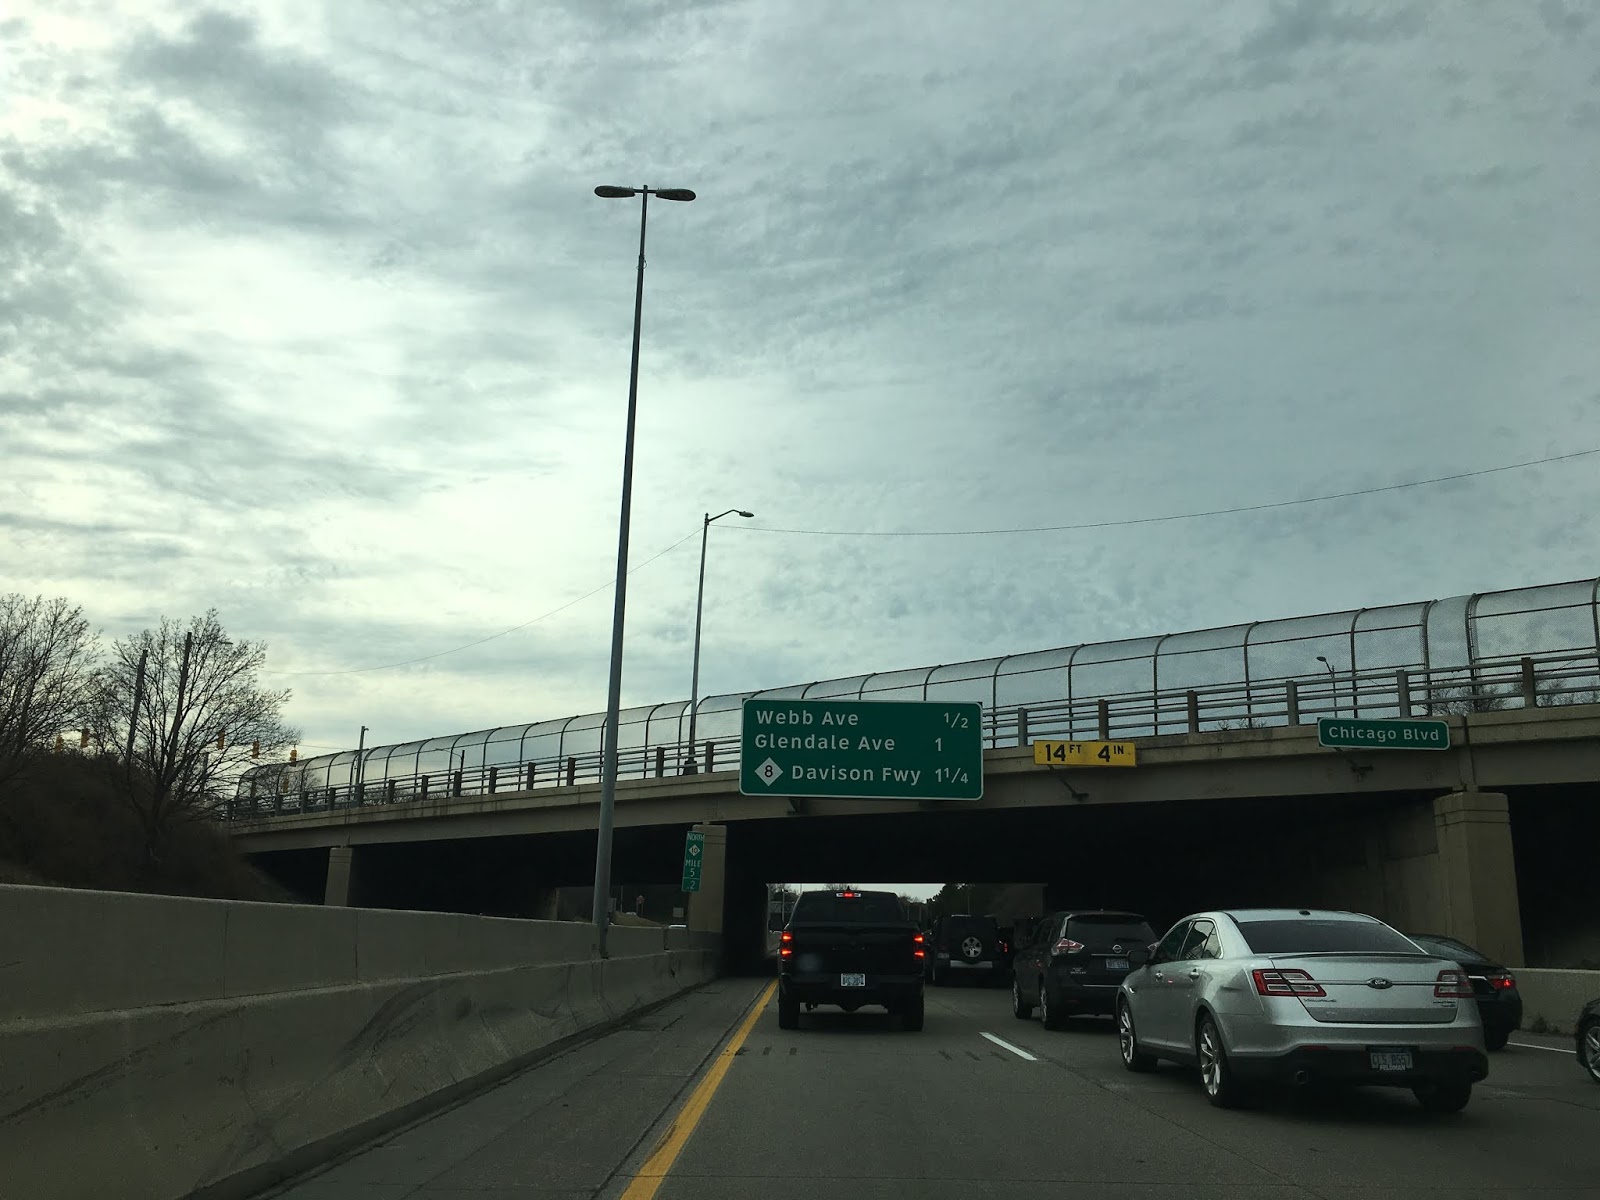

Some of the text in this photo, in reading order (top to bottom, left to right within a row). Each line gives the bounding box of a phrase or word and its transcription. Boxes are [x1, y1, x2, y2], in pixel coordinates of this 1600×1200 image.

[756, 710, 814, 726] Webb
[821, 711, 859, 726] Ave
[754, 733, 942, 752] Glendale Ave 1
[1328, 726, 1439, 743] Chicago Blvd
[1045, 743, 1124, 763] 14 FT 4 IN
[764, 764, 773, 778] 8
[792, 765, 875, 782] Davison
[882, 767, 921, 786] Fwy
[687, 832, 705, 841] NORTH
[685, 859, 701, 868] MILE
[690, 867, 695, 877] 5
